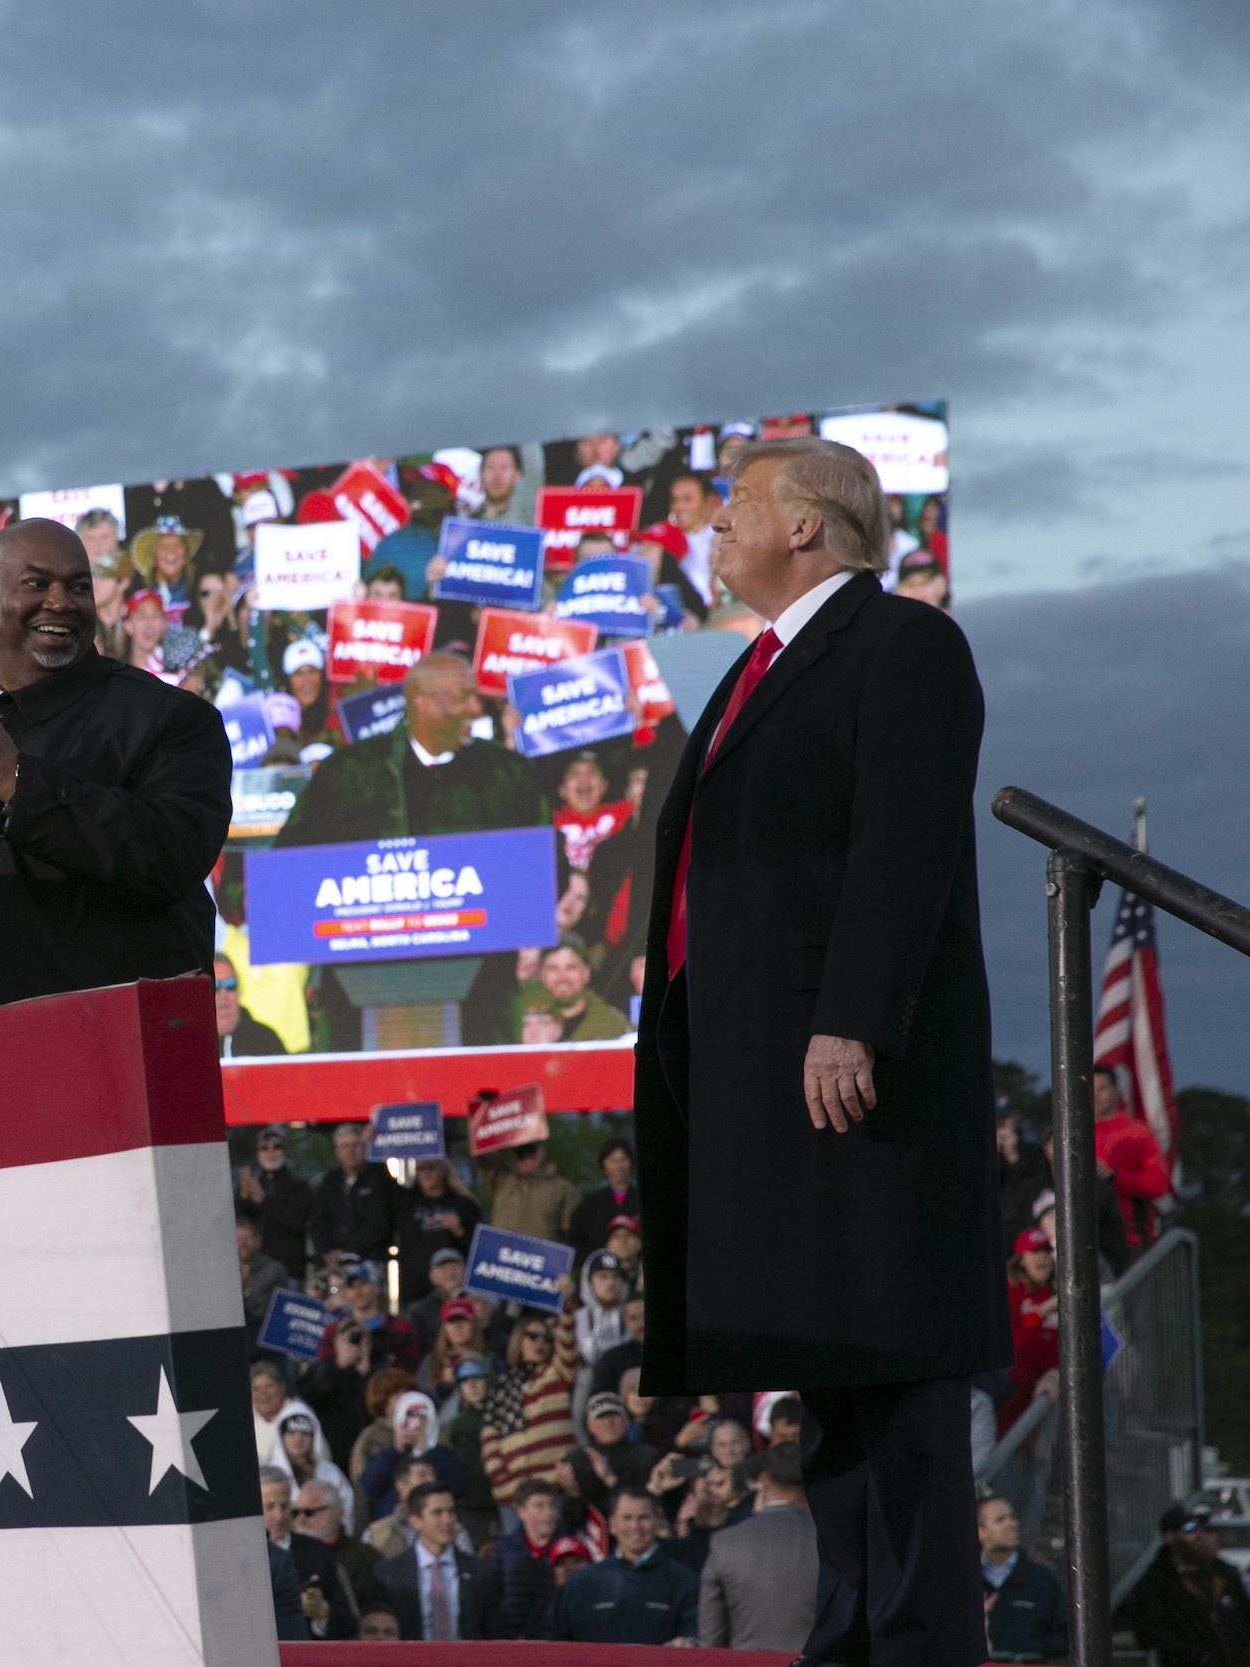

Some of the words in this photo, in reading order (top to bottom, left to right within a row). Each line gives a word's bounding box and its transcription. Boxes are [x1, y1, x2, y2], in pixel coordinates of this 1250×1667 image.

[565, 507, 616, 527] SAVE
[284, 549, 328, 562] SAVE
[465, 539, 517, 564] SAVE
[444, 561, 534, 589] AMERICA!
[572, 572, 626, 595] SAVE
[352, 618, 405, 643] SAVE
[508, 632, 562, 659] SAVE
[540, 674, 597, 706] SAVE
[523, 693, 624, 735] AMERICA!
[366, 849, 430, 875] SAVE
[315, 866, 484, 908] AMERICA
[387, 1115, 423, 1130] SAVE
[488, 1100, 522, 1120] SAVE
[476, 1112, 539, 1139] AMERICA!
[375, 1130, 438, 1147] AMERICA!
[497, 1246, 546, 1272] SAVE
